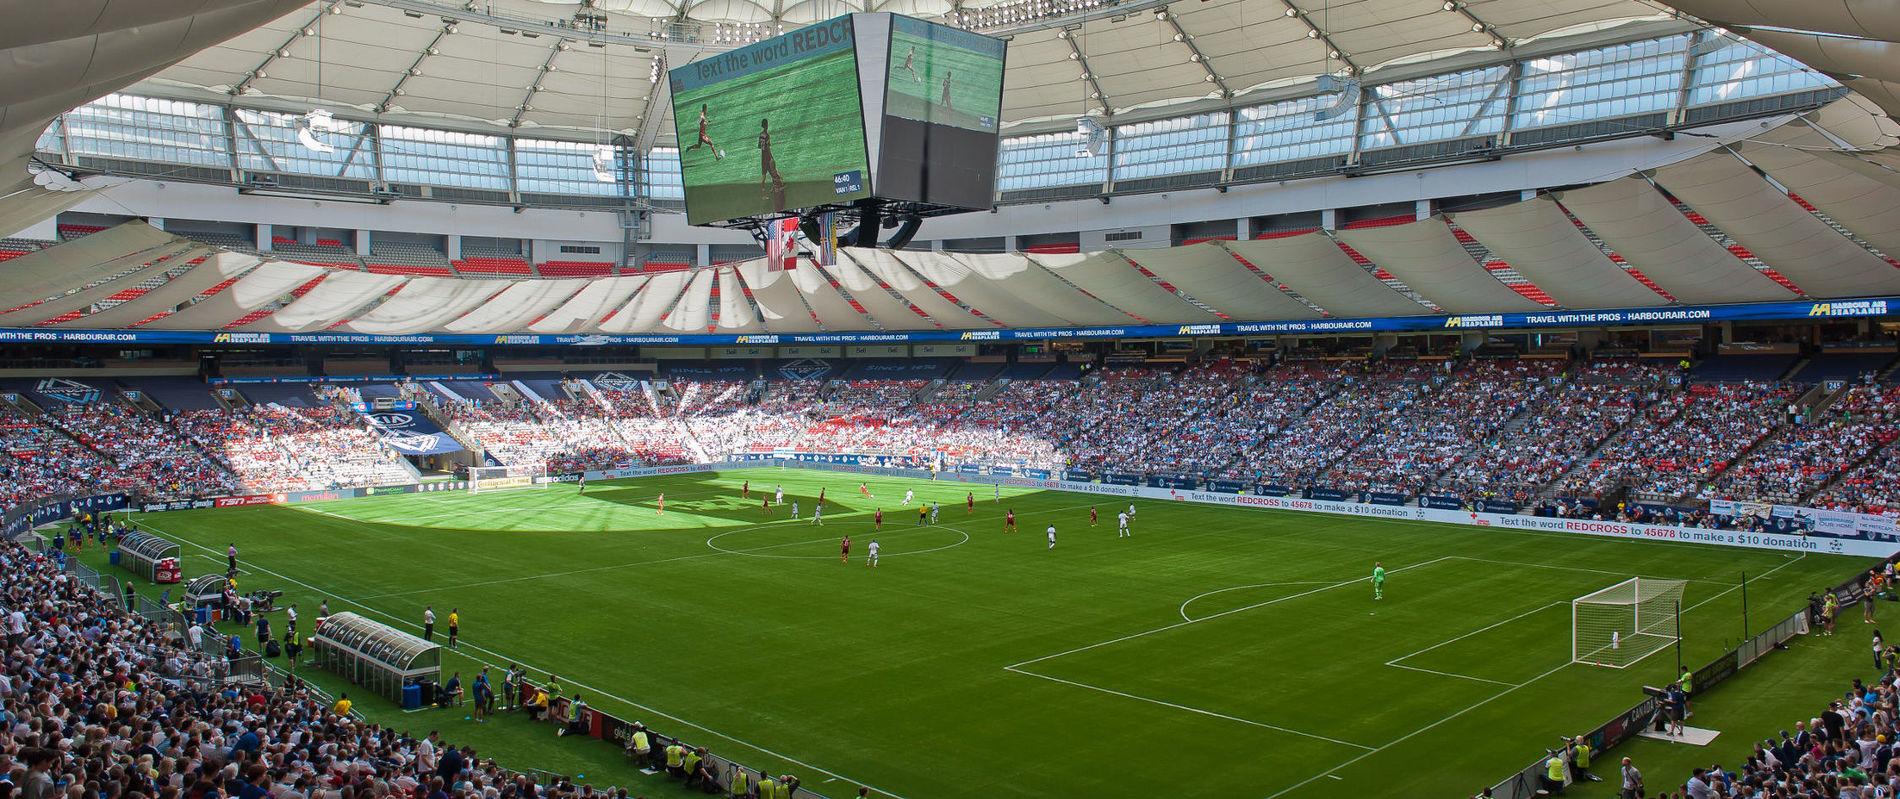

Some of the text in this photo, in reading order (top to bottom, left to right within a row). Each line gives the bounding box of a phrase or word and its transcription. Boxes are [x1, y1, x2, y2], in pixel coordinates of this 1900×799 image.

[694, 60, 722, 80] Text
[725, 52, 749, 72] the
[751, 36, 790, 65] word
[1831, 302, 1870, 310] HARBOUR
[1831, 308, 1888, 316] SEAPLANES
[1526, 310, 1710, 324] TRAVEL WITH THE PROS HARBOURAIR.COM
[1310, 322, 1372, 330] HARBOURAIR.COM
[64, 332, 136, 341] HARBOURAIR.COM
[1100, 485, 1126, 494] donation
[1237, 496, 1280, 506] REDCROSS
[1324, 504, 1346, 512] make
[1354, 504, 1370, 514] $10
[1371, 506, 1408, 517] donation
[1500, 516, 1519, 526] Text
[1520, 517, 1537, 527] the
[1539, 520, 1564, 529] word
[1566, 522, 1628, 534] REDCROSS
[1630, 526, 1642, 536] to
[1644, 528, 1676, 538] 45678
[1679, 530, 1690, 539] to
[1693, 532, 1724, 542] make
[1738, 534, 1759, 545] $10
[1762, 538, 1817, 549] donation
